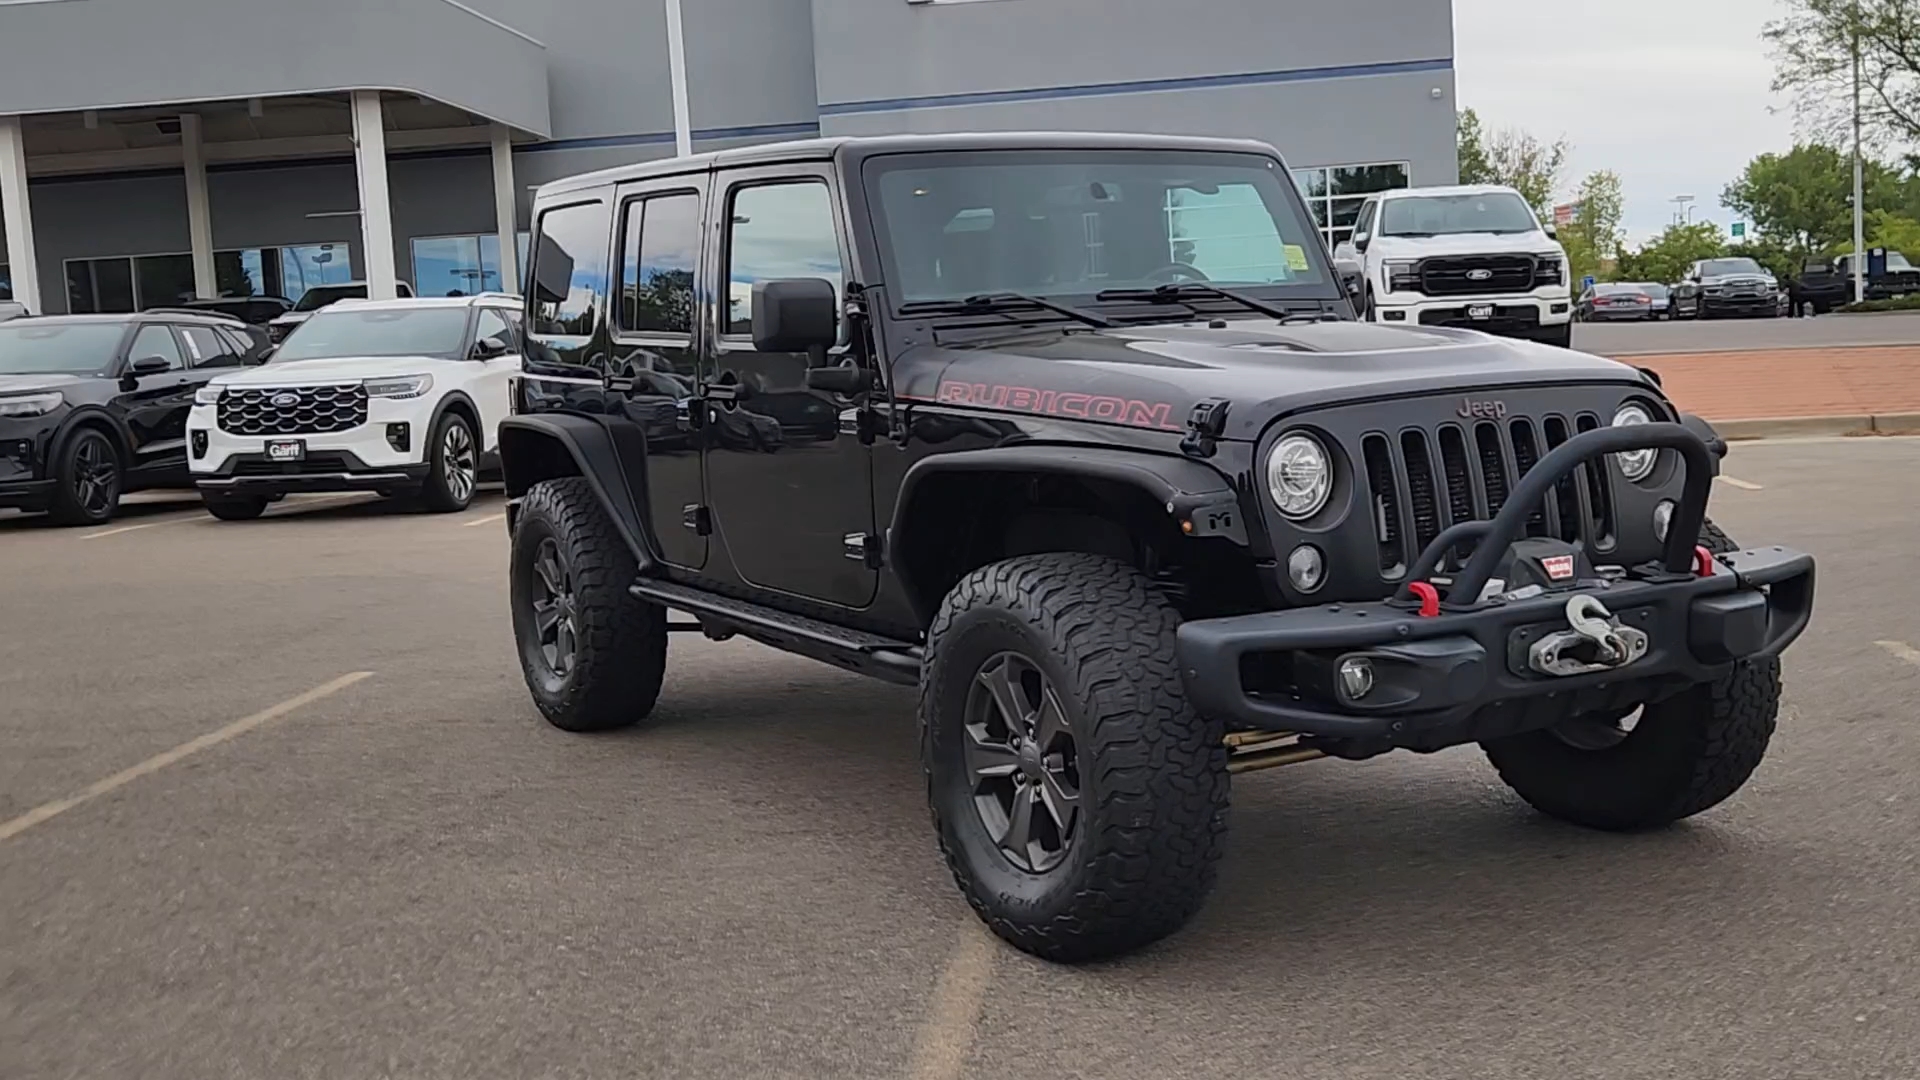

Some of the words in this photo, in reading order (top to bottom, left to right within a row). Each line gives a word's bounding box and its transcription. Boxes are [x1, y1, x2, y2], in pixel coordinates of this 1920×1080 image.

[938, 380, 1180, 430] RUBICON
[1456, 397, 1507, 419] Jeep
[269, 443, 300, 457] Garff
